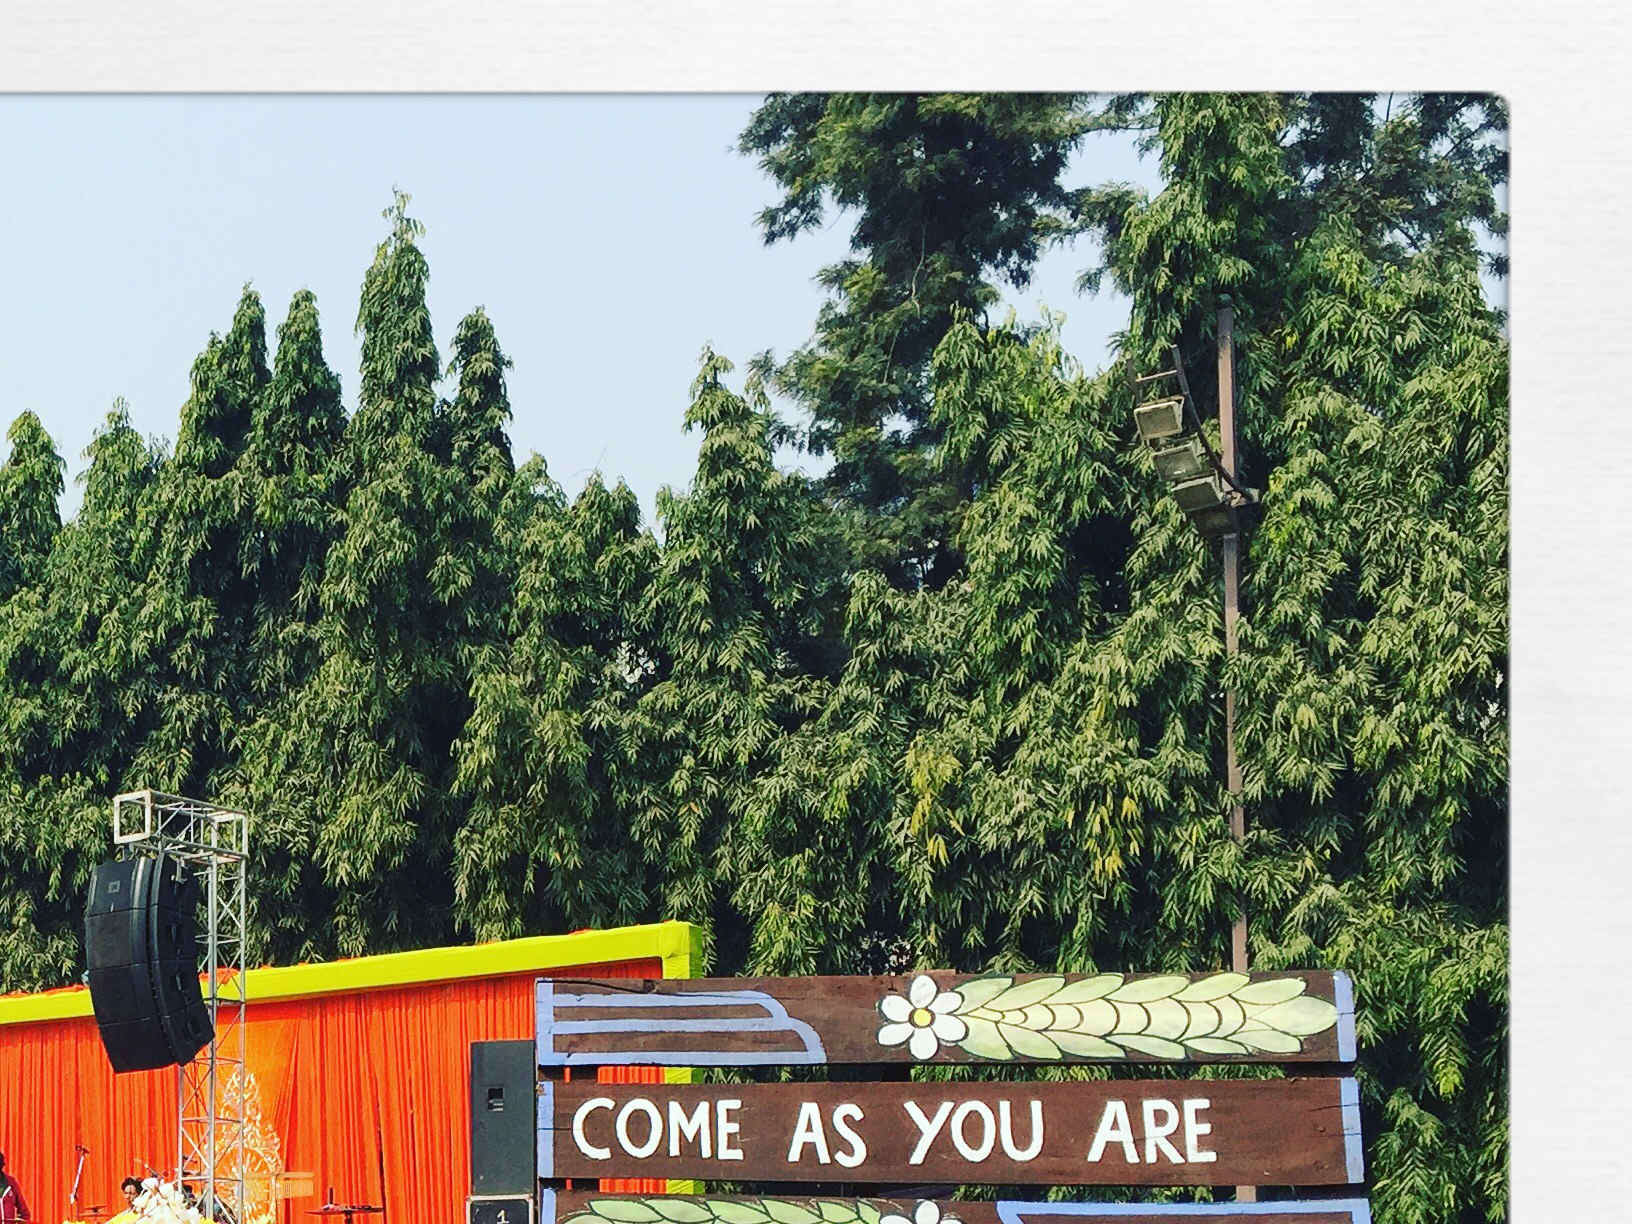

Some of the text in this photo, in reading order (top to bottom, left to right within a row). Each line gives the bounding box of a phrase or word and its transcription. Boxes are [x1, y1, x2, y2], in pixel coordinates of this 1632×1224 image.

[572, 1097, 1218, 1168] COME AS YOU ARE
[496, 1209, 509, 1224] 1
